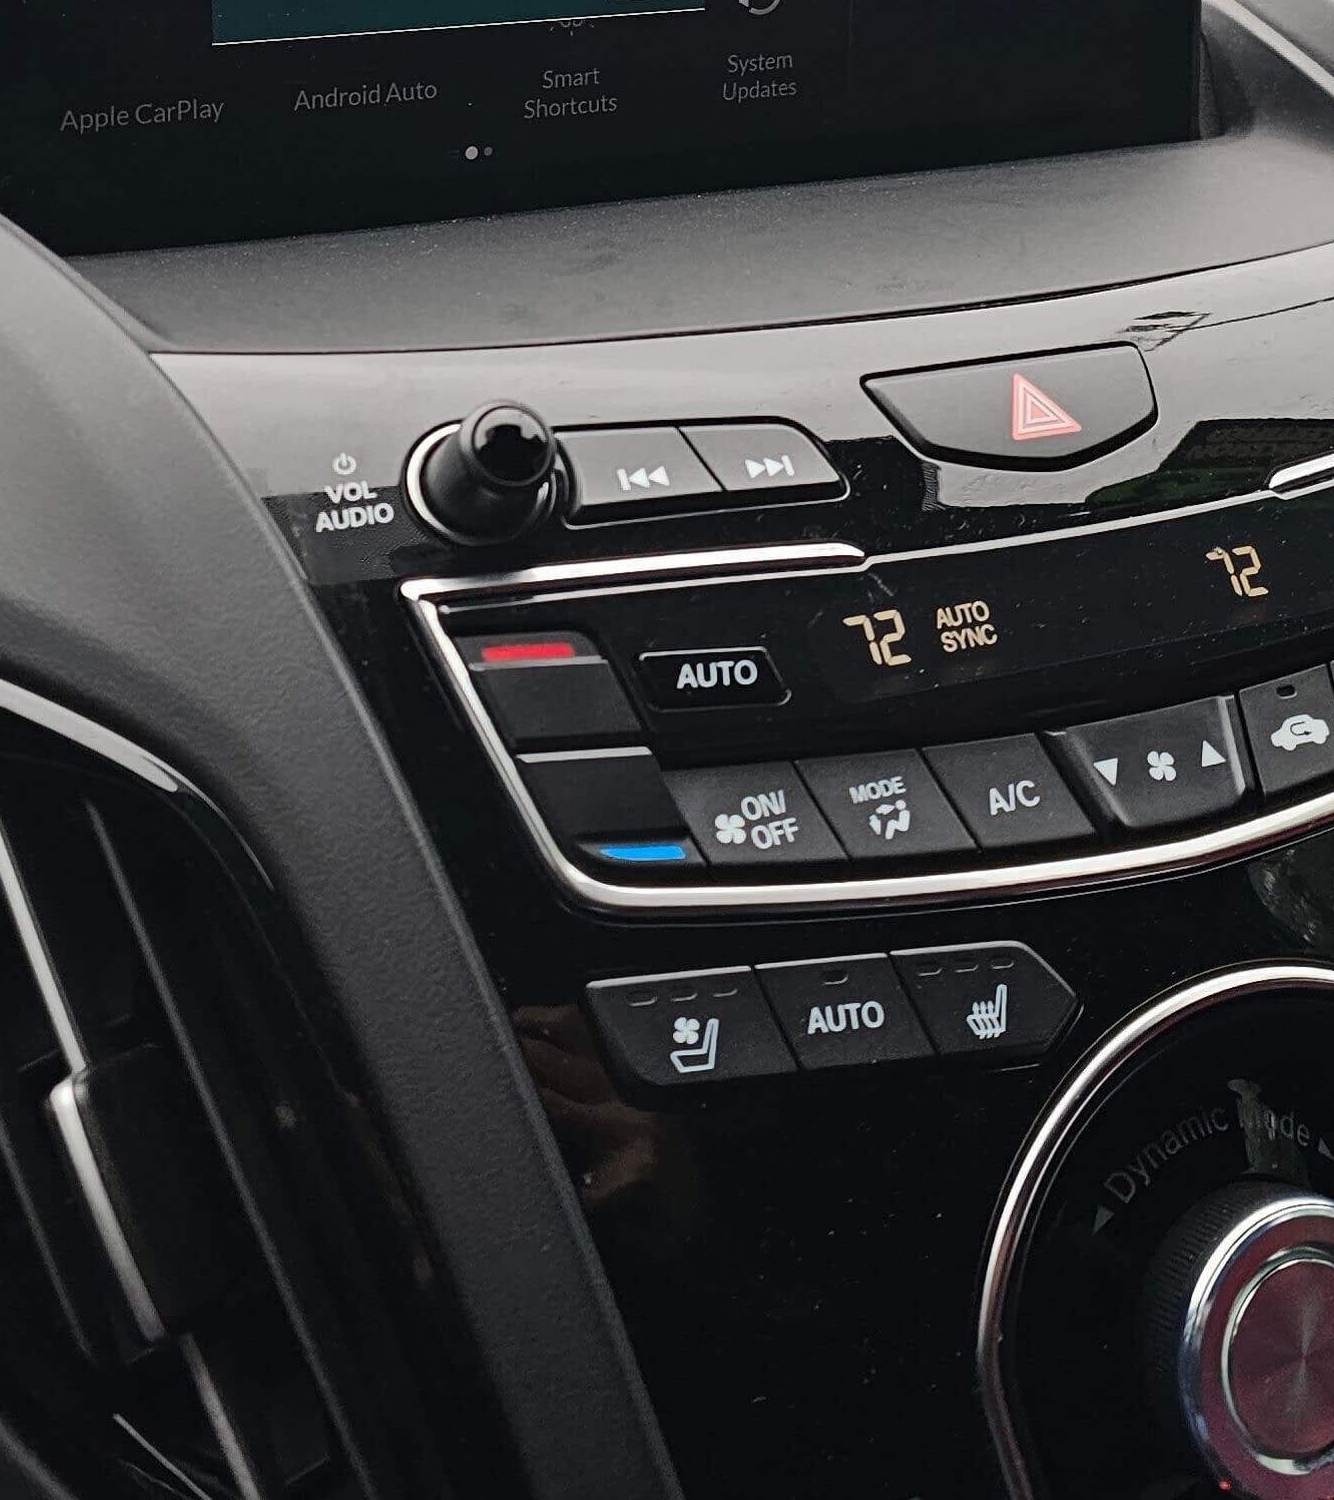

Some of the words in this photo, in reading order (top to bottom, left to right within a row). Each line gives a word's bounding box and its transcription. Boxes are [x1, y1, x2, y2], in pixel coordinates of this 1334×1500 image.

[542, 67, 600, 89] Smart
[727, 53, 794, 77] System
[293, 84, 381, 112] Android
[385, 83, 438, 104] Auto
[722, 79, 797, 104] Updates
[60, 105, 130, 135] Apple
[135, 98, 225, 125] CarPlay
[523, 95, 617, 119] Shortcuts
[324, 481, 377, 503] VOL
[315, 503, 395, 533] AUDIO
[1205, 545, 1269, 597] 72
[936, 601, 990, 630] AUTO
[843, 609, 912, 666] 72
[941, 625, 998, 653] SYNC
[676, 659, 758, 689] AUTO
[849, 776, 906, 804] MODE
[988, 780, 1041, 816] A/C
[740, 790, 787, 821] ON/
[750, 817, 799, 850] OFF
[807, 1001, 885, 1035] AUTO
[1102, 1105, 1230, 1205] Dynamic
